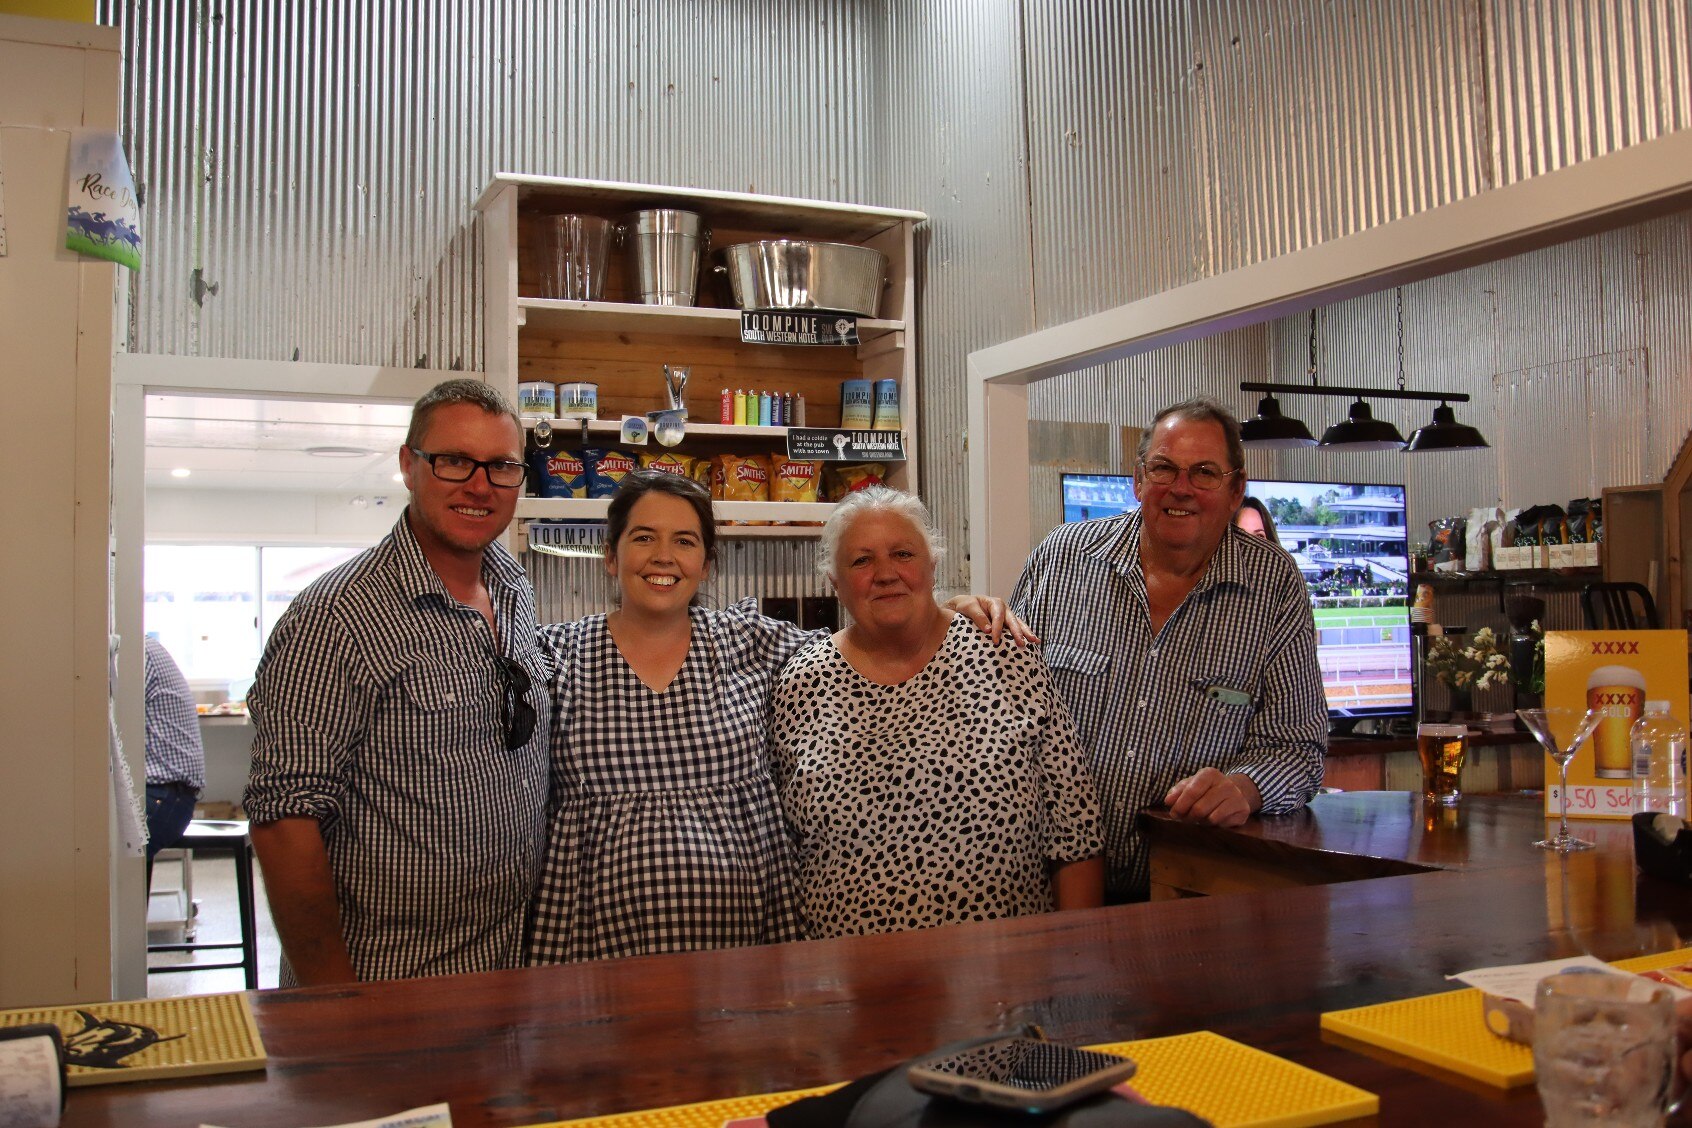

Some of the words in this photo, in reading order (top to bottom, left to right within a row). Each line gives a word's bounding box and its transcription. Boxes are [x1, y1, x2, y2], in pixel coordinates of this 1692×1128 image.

[77, 173, 116, 200] Race
[120, 187, 138, 220] Day
[743, 313, 817, 334] TOOMPINE
[744, 329, 765, 341] SOUTH
[766, 330, 797, 342] WESTERN
[798, 333, 819, 344] HOTEL
[851, 432, 899, 444] TOOMPINE
[851, 442, 866, 450] SOUTH
[548, 459, 584, 472] SMITH'S
[596, 459, 634, 471] SMITH'S
[737, 466, 766, 480] SMITH'S
[532, 527, 604, 545] TOOMPIN
[1591, 641, 1639, 654] XXXX
[1595, 693, 1636, 705] XXXX
[1601, 706, 1632, 718] GOLD
